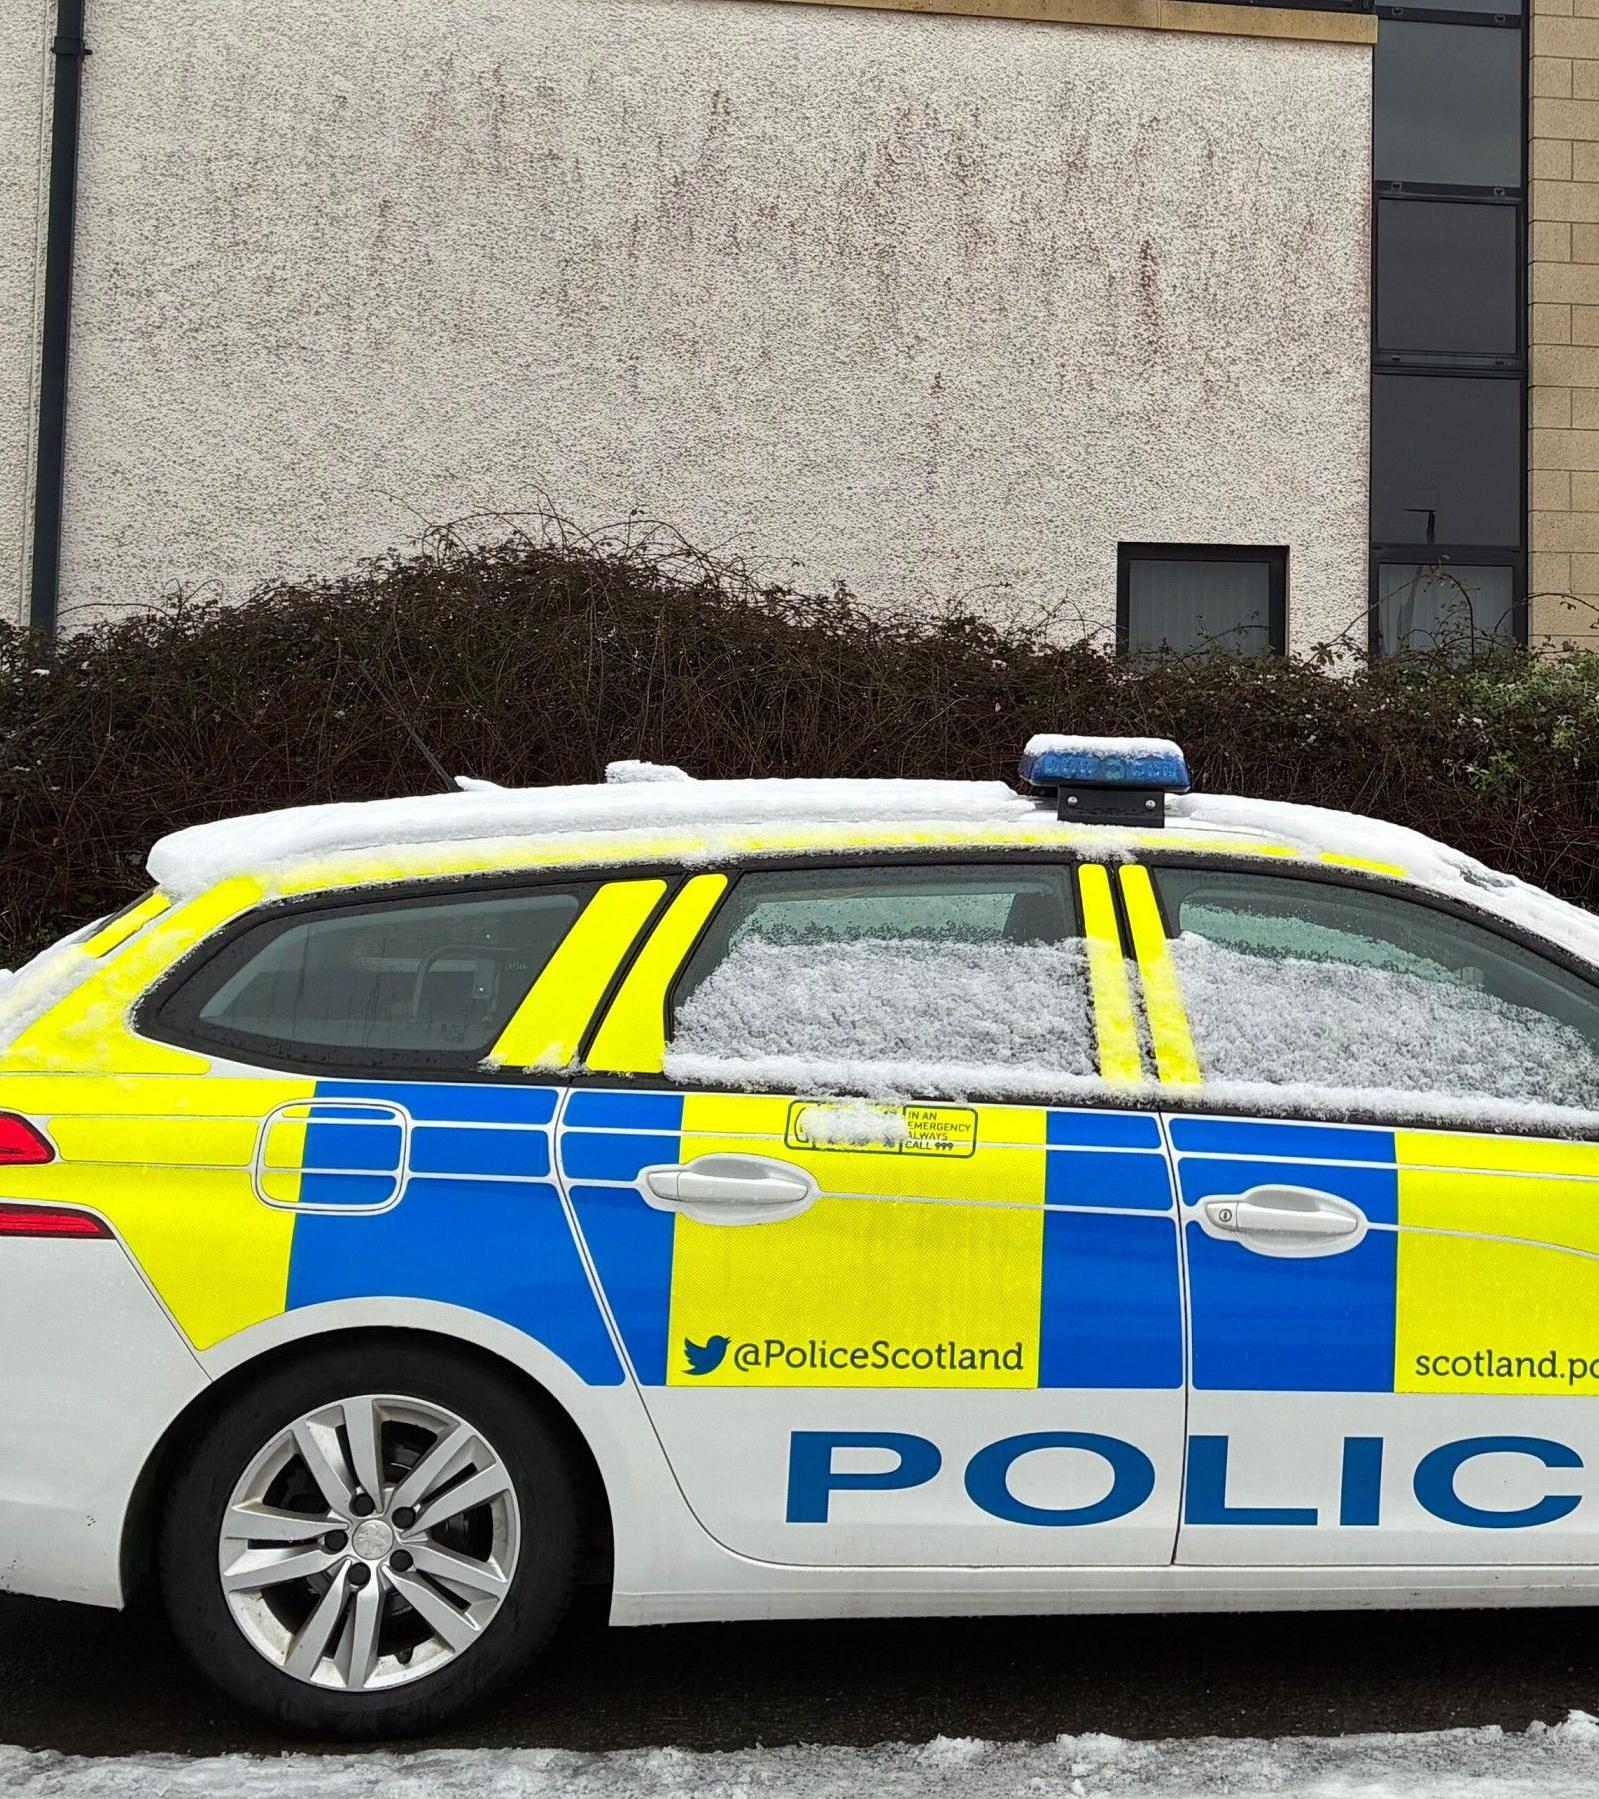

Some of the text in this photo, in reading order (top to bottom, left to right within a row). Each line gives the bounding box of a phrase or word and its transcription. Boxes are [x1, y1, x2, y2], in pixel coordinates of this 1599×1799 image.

[908, 1111, 937, 1120] IN AN
[907, 1121, 971, 1132] EMERGENCY
[908, 1131, 948, 1141] ALWAYS
[905, 1141, 932, 1150] CALL
[934, 1142, 954, 1151] 999
[734, 1339, 1024, 1372] @PoliceScotland
